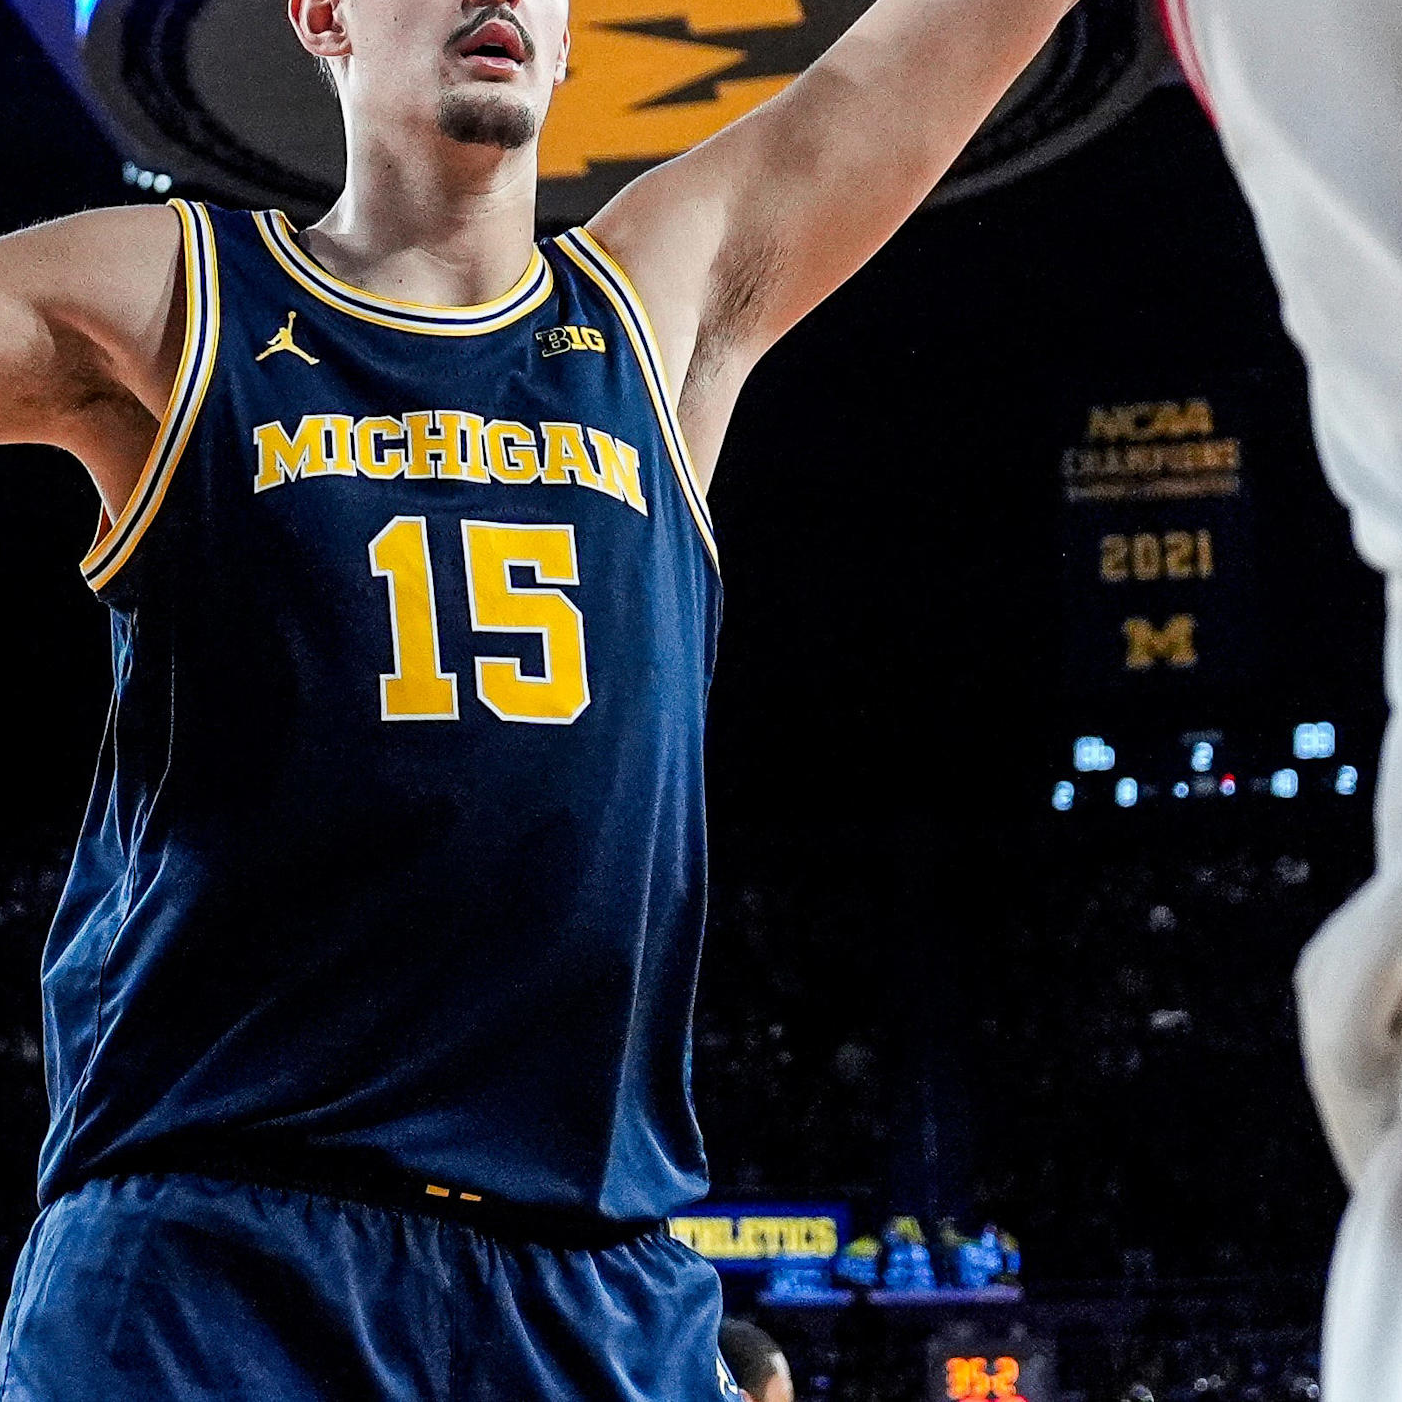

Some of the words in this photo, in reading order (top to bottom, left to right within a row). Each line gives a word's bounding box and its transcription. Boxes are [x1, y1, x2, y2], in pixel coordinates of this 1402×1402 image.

[253, 410, 648, 516] MICHIGAN
[1100, 529, 1214, 582] 2021
[368, 515, 592, 725] 15
[1121, 612, 1198, 672] M
